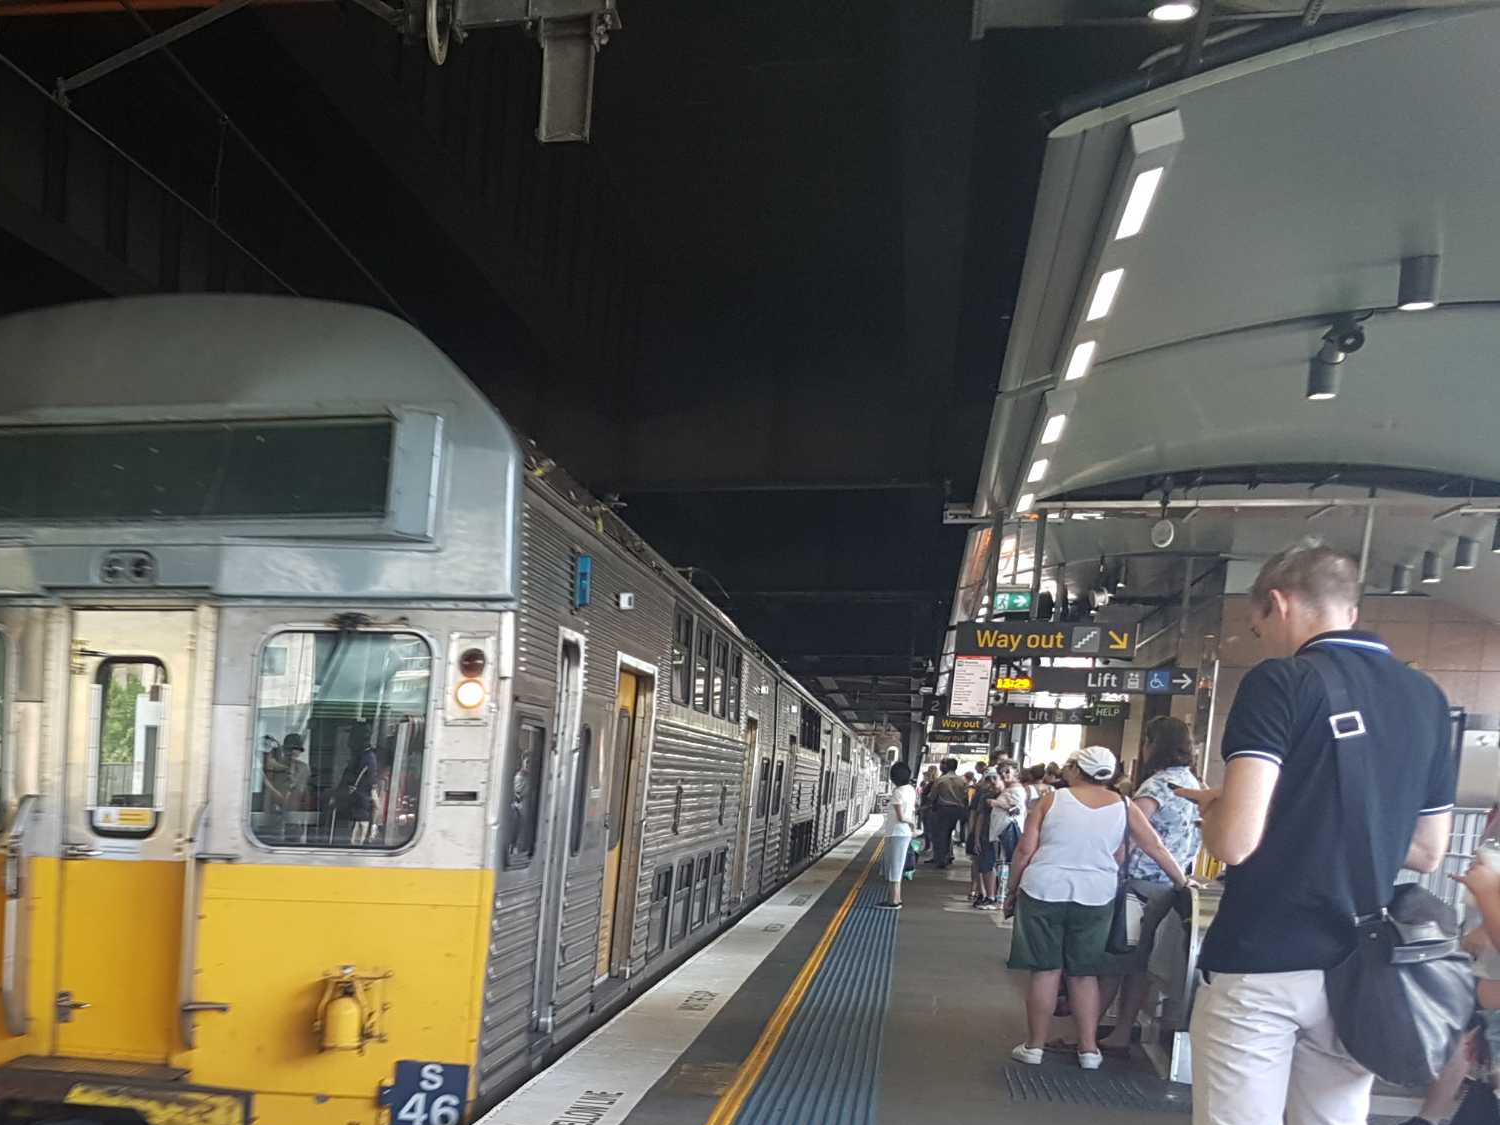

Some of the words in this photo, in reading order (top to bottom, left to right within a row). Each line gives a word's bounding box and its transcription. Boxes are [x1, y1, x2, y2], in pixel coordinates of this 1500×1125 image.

[976, 629, 1022, 652] Way
[1027, 631, 1064, 648] out
[1087, 672, 1117, 688] Lift
[930, 700, 941, 712] 2
[1095, 707, 1120, 717] HELP
[1028, 710, 1049, 721] Lift
[941, 719, 962, 730] Way
[963, 720, 981, 729] out
[420, 1063, 445, 1091] S
